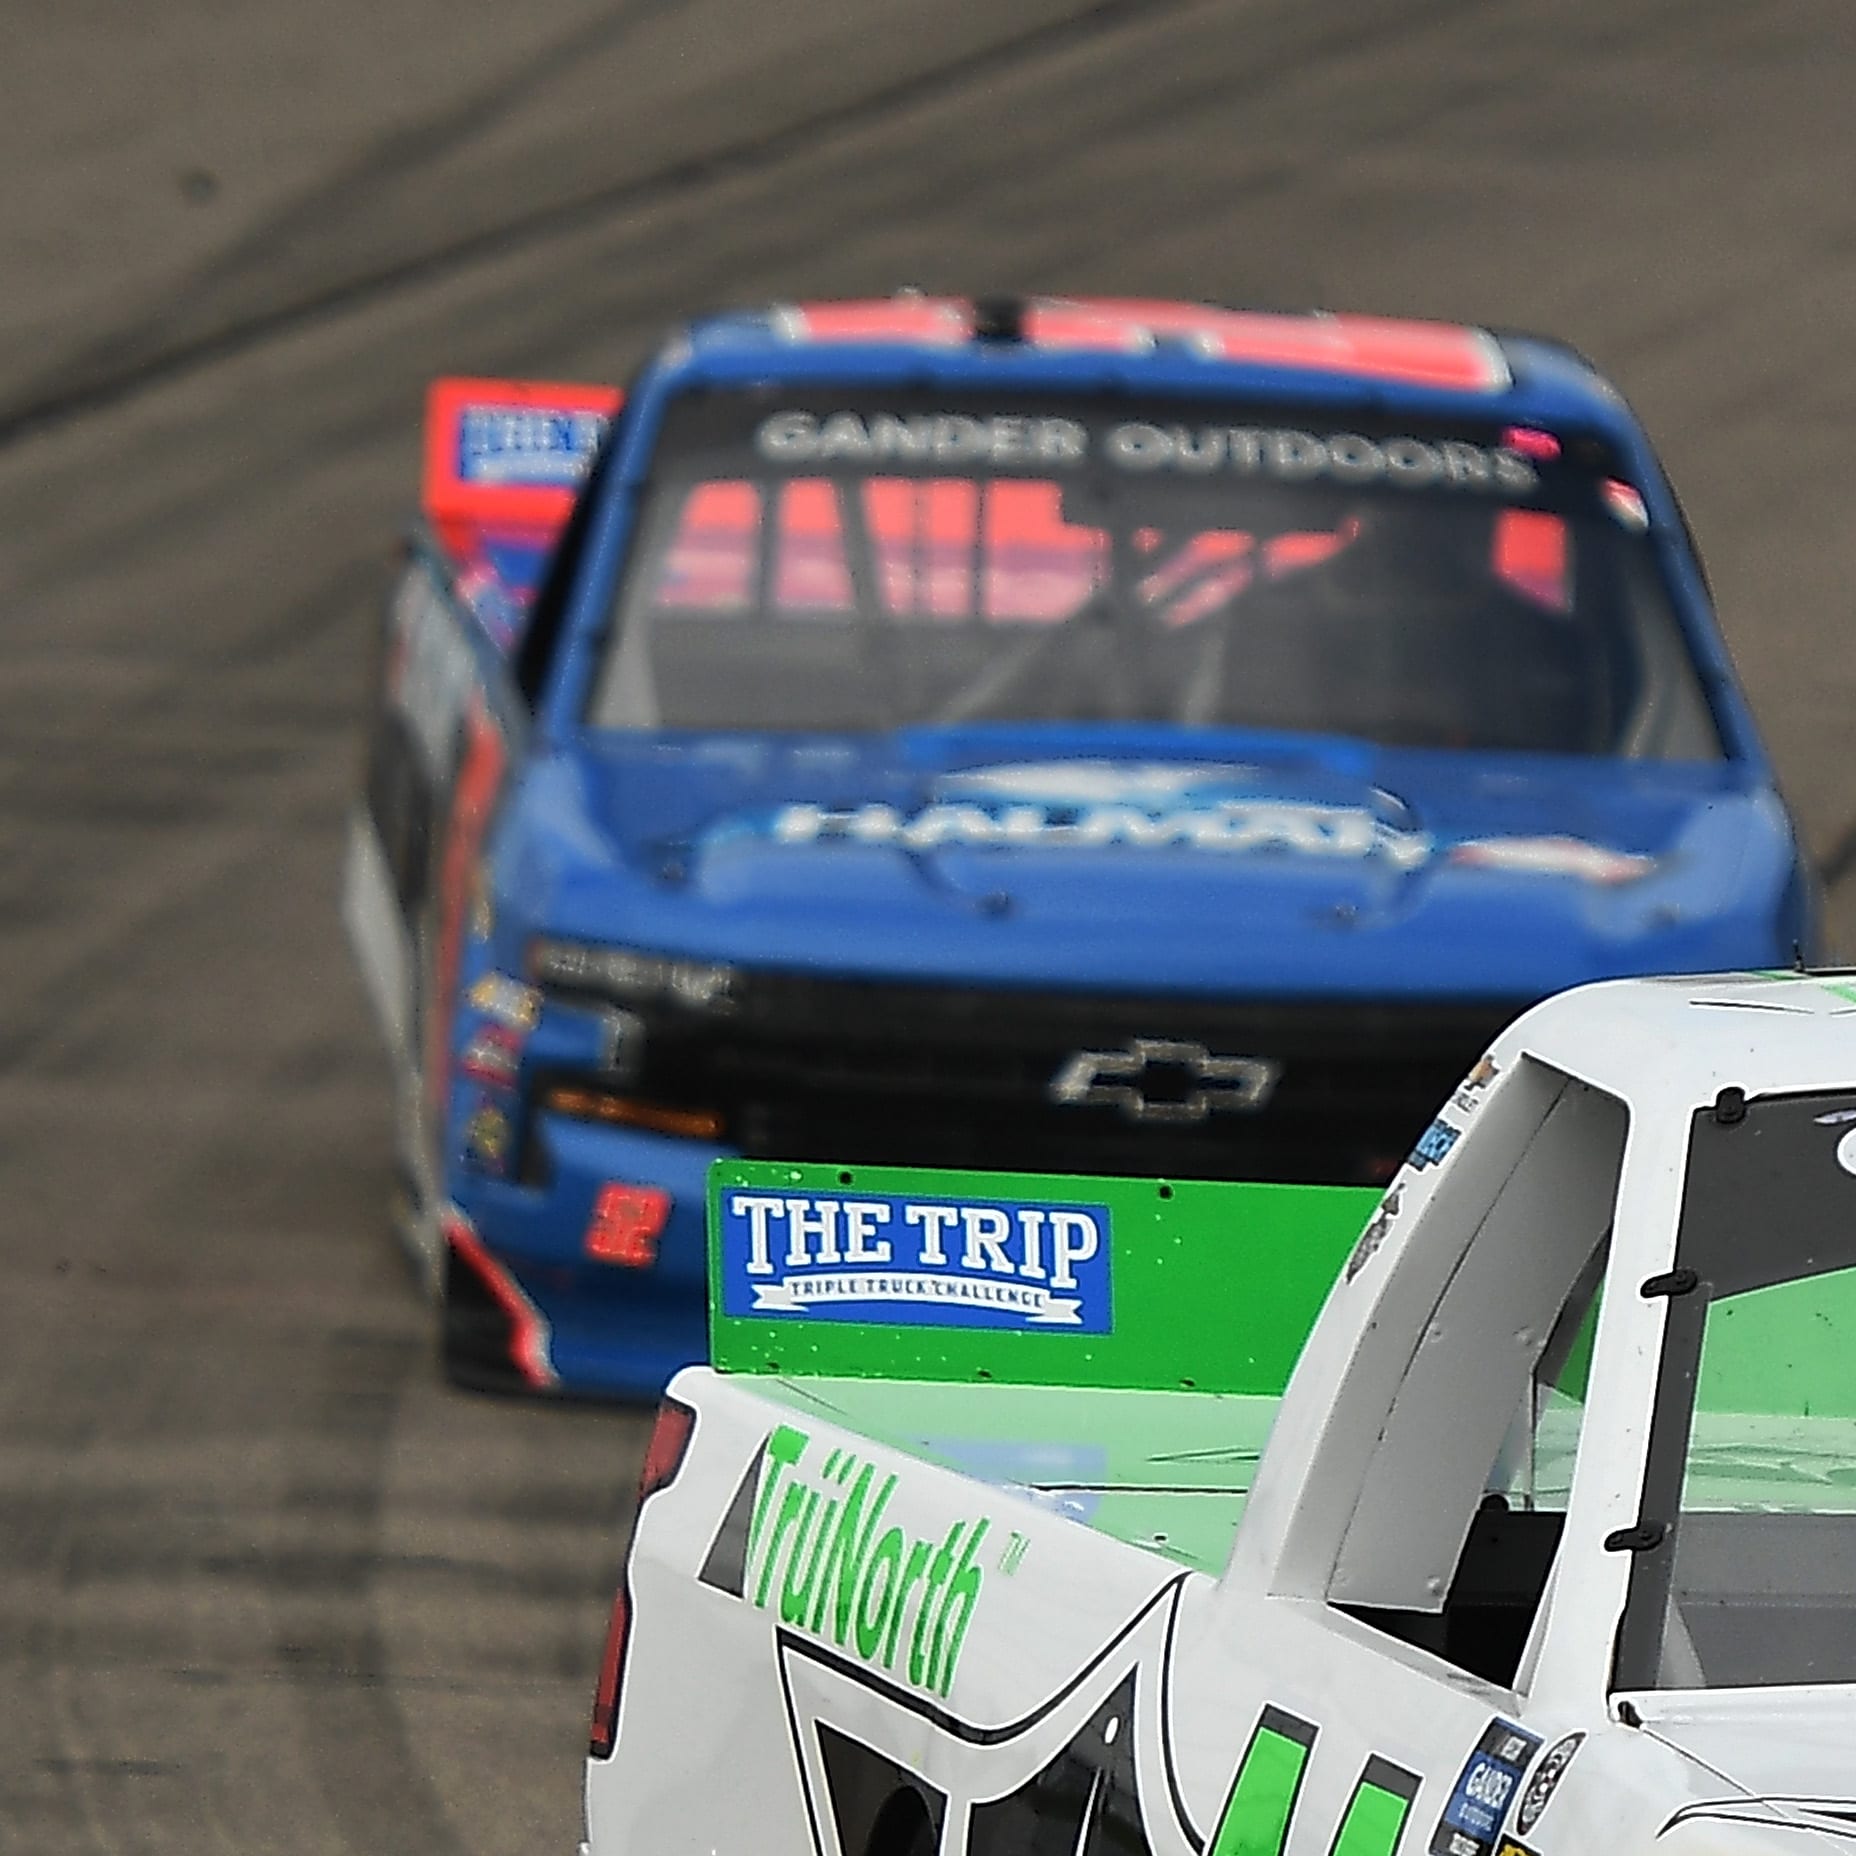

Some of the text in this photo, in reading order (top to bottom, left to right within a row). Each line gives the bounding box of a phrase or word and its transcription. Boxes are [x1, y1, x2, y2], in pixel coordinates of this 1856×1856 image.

[757, 410, 1541, 490] GANDER OUTDOORS
[732, 1196, 1099, 1289] THE TRIP
[791, 1278, 1044, 1309] TRIPLE TRUCK CHALLENGE
